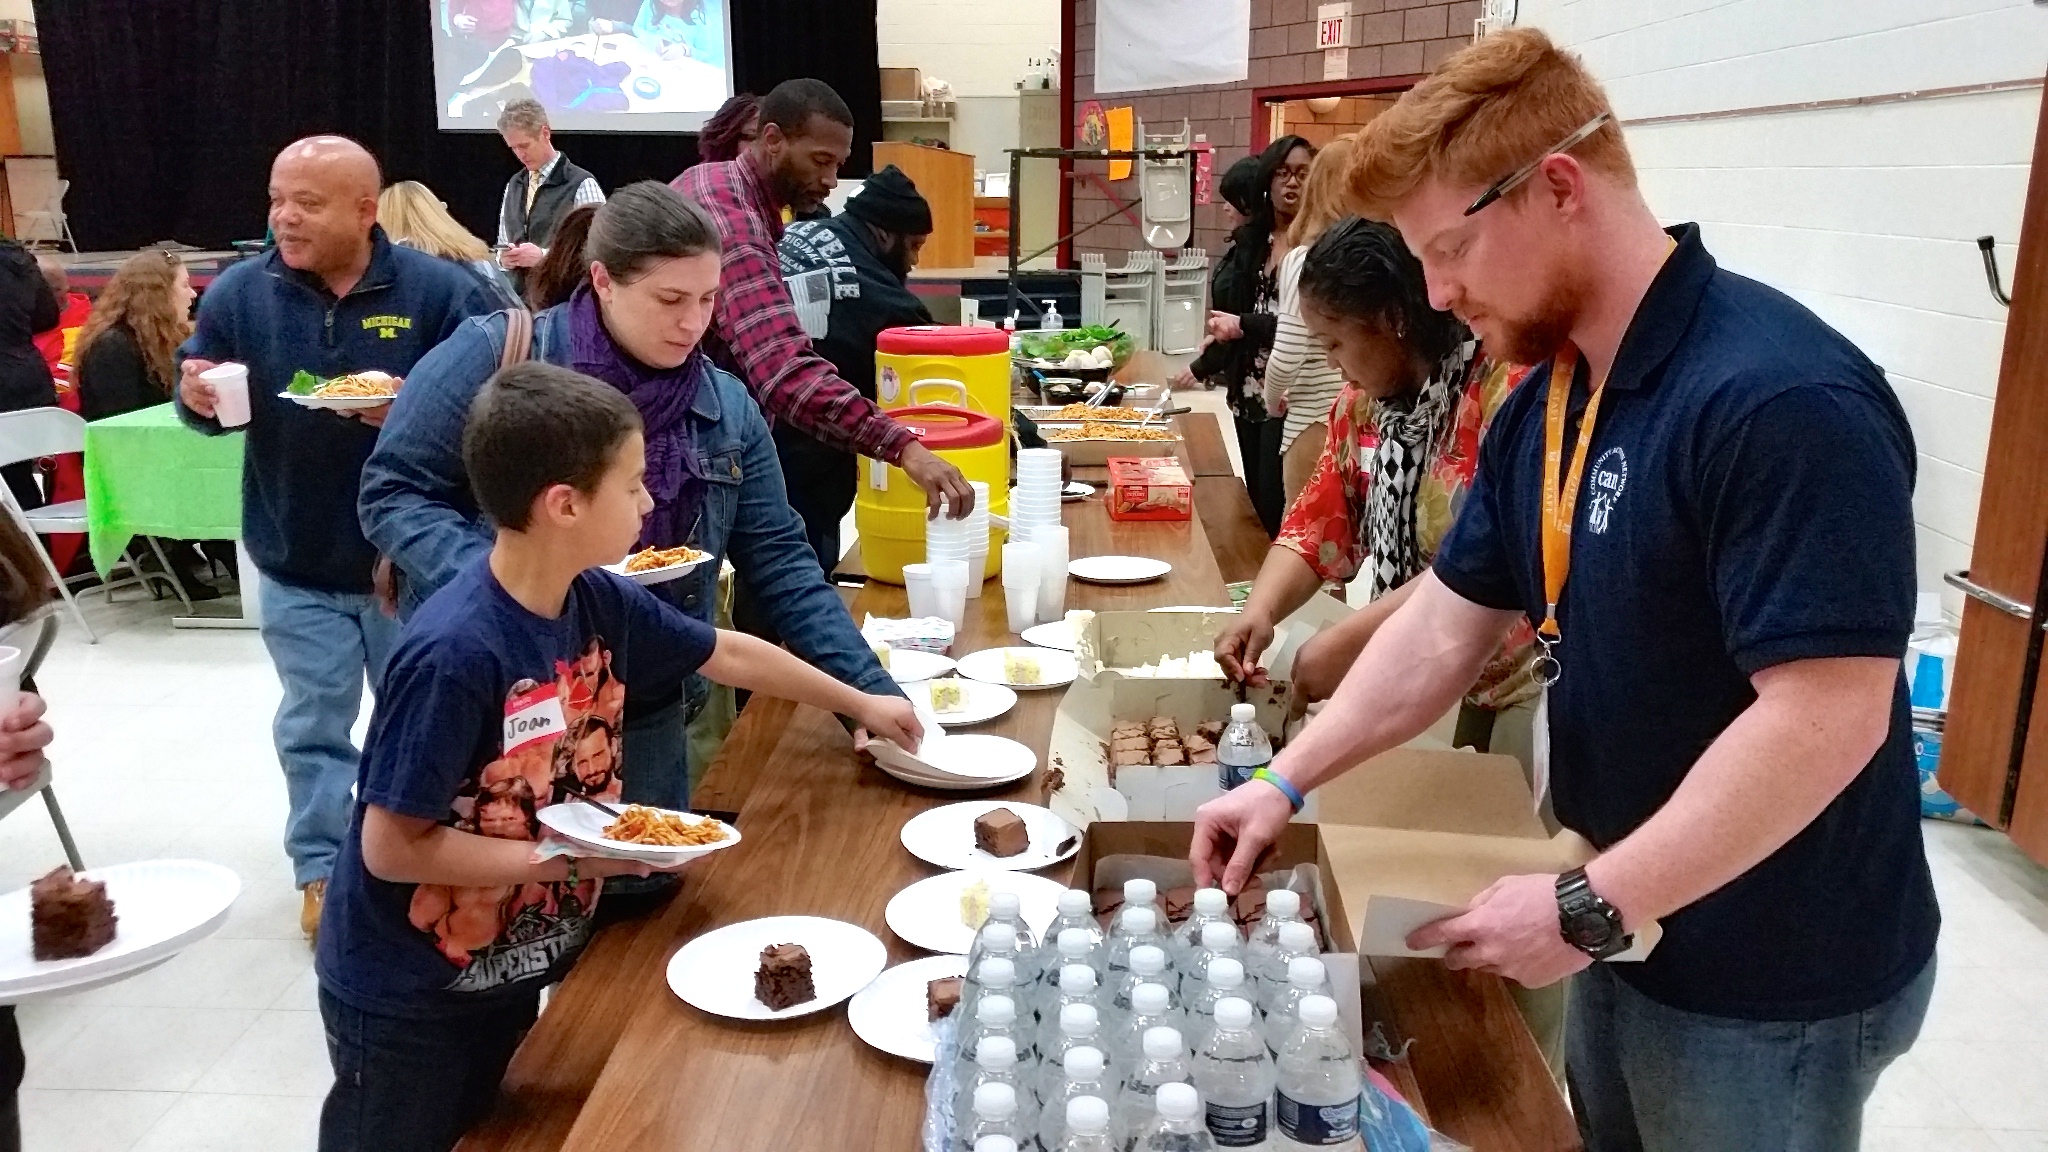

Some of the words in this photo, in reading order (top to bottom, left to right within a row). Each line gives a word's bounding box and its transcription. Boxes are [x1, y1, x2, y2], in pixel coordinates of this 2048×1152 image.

[1321, 19, 1342, 45] EXIT
[777, 250, 806, 273] ERICAN
[781, 234, 822, 265] RIGINAL
[808, 228, 860, 300] PELLE
[361, 315, 412, 330] MICHIGAN
[379, 327, 398, 338] M
[1590, 448, 1613, 496] COMMUNITY
[1612, 460, 1628, 504] NETWORK
[1598, 470, 1619, 490] can
[507, 716, 551, 739] Joan
[450, 932, 586, 992] SUPERST
